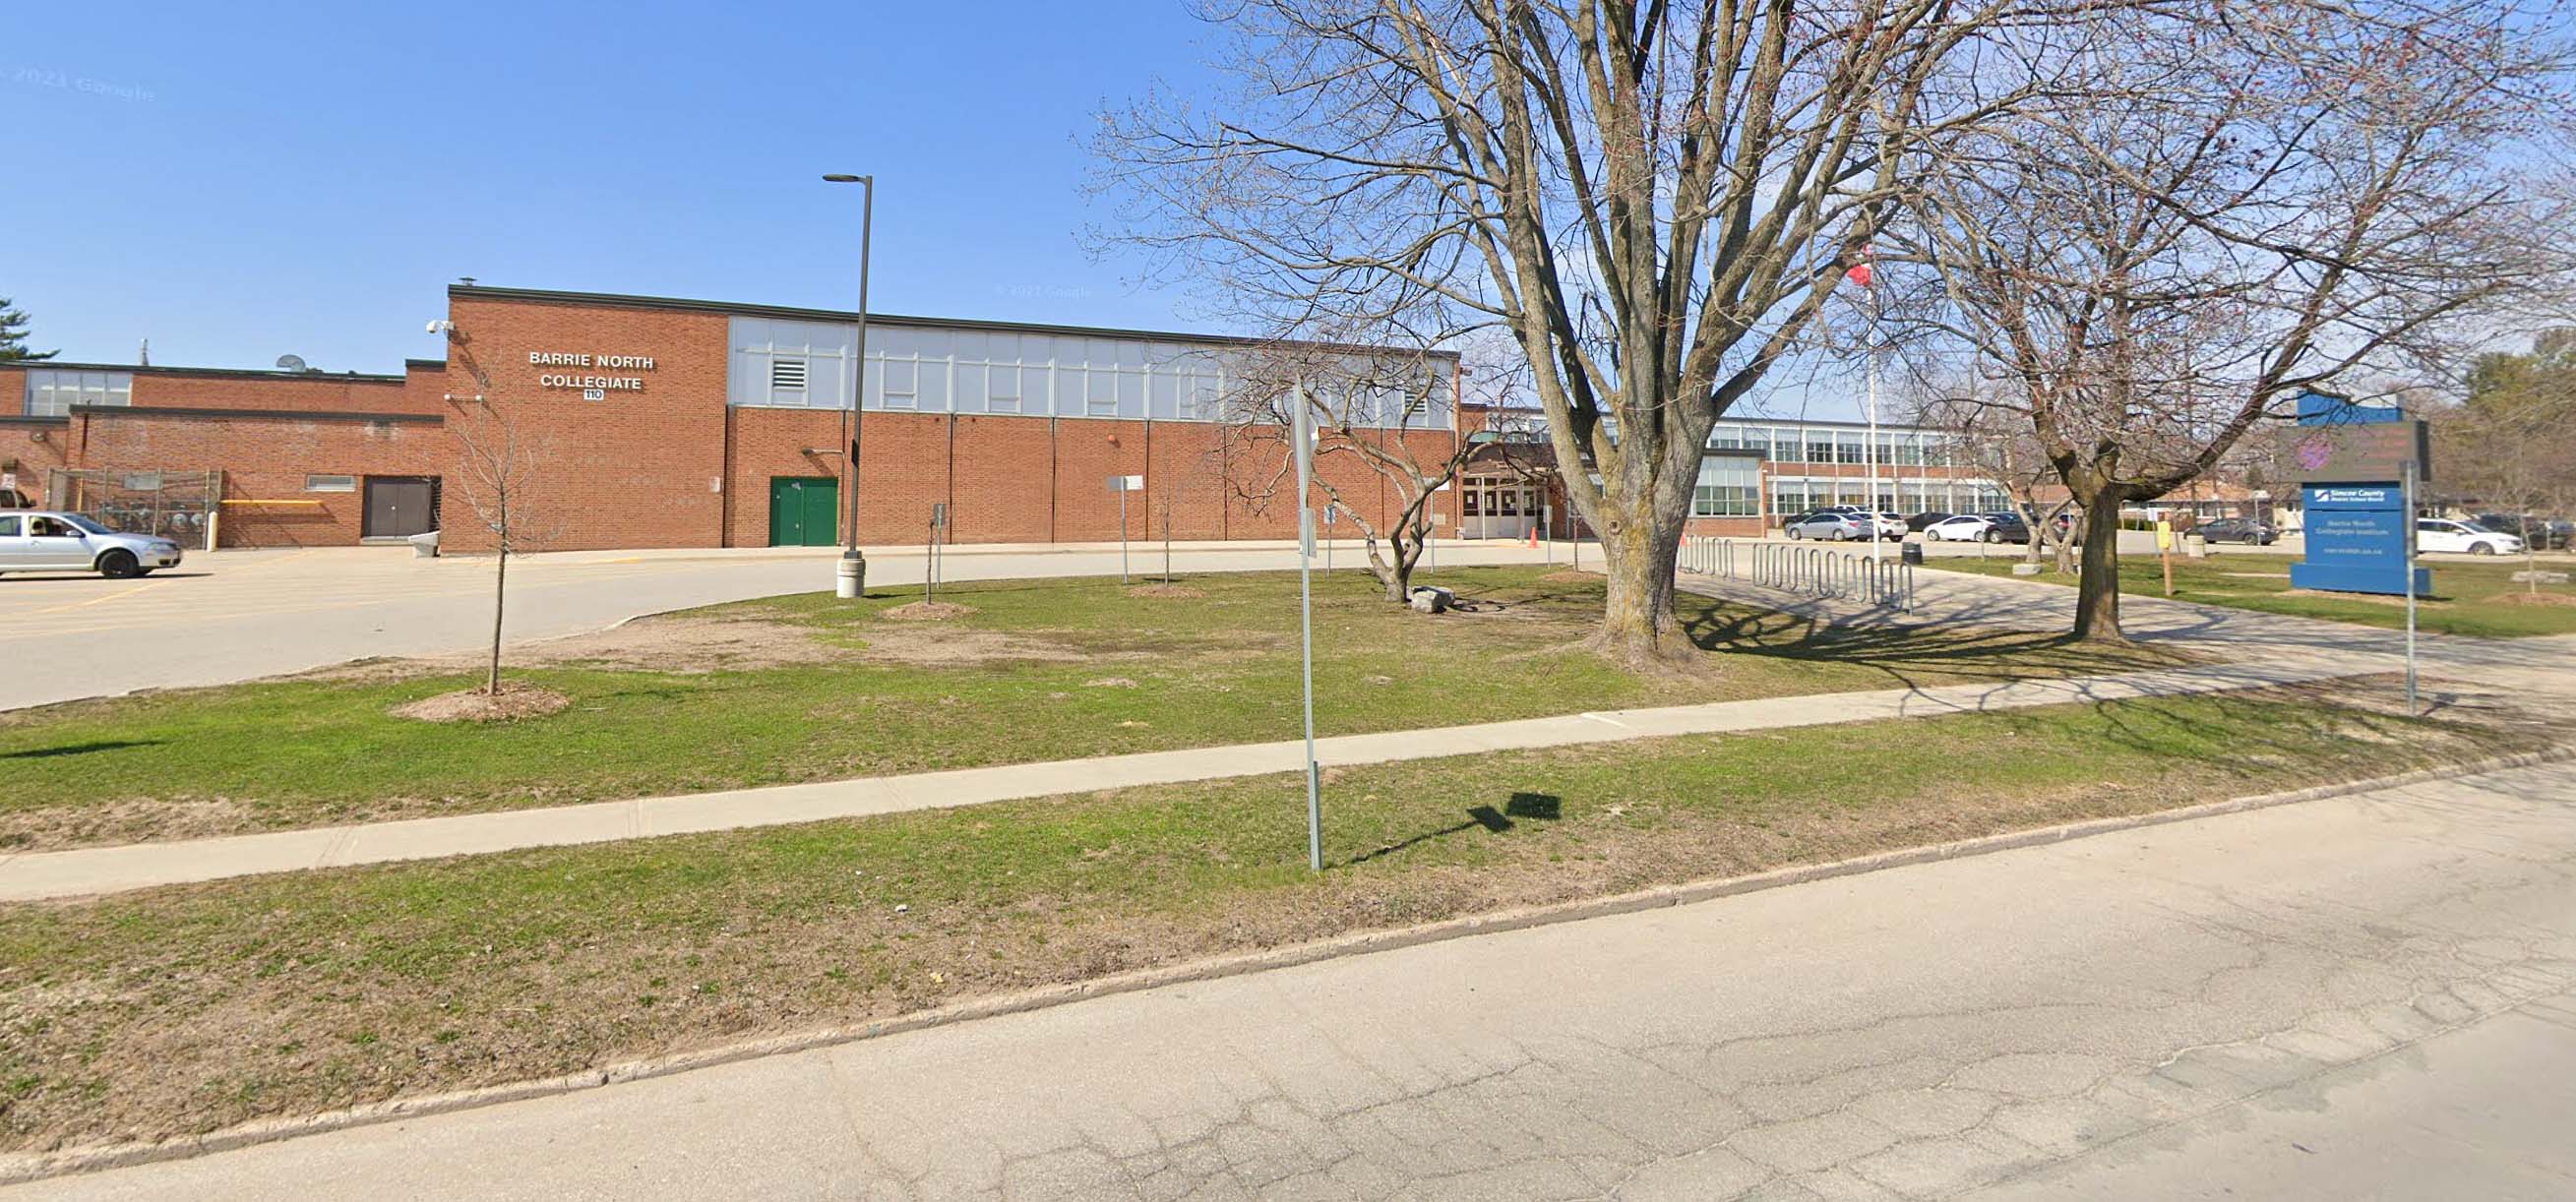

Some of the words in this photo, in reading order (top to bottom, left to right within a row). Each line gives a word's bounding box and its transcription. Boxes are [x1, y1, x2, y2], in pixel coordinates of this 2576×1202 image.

[529, 351, 590, 367] BARRIE
[597, 354, 654, 369] NORTH
[540, 374, 643, 390] COLLEGIATE
[585, 390, 603, 399] 110
